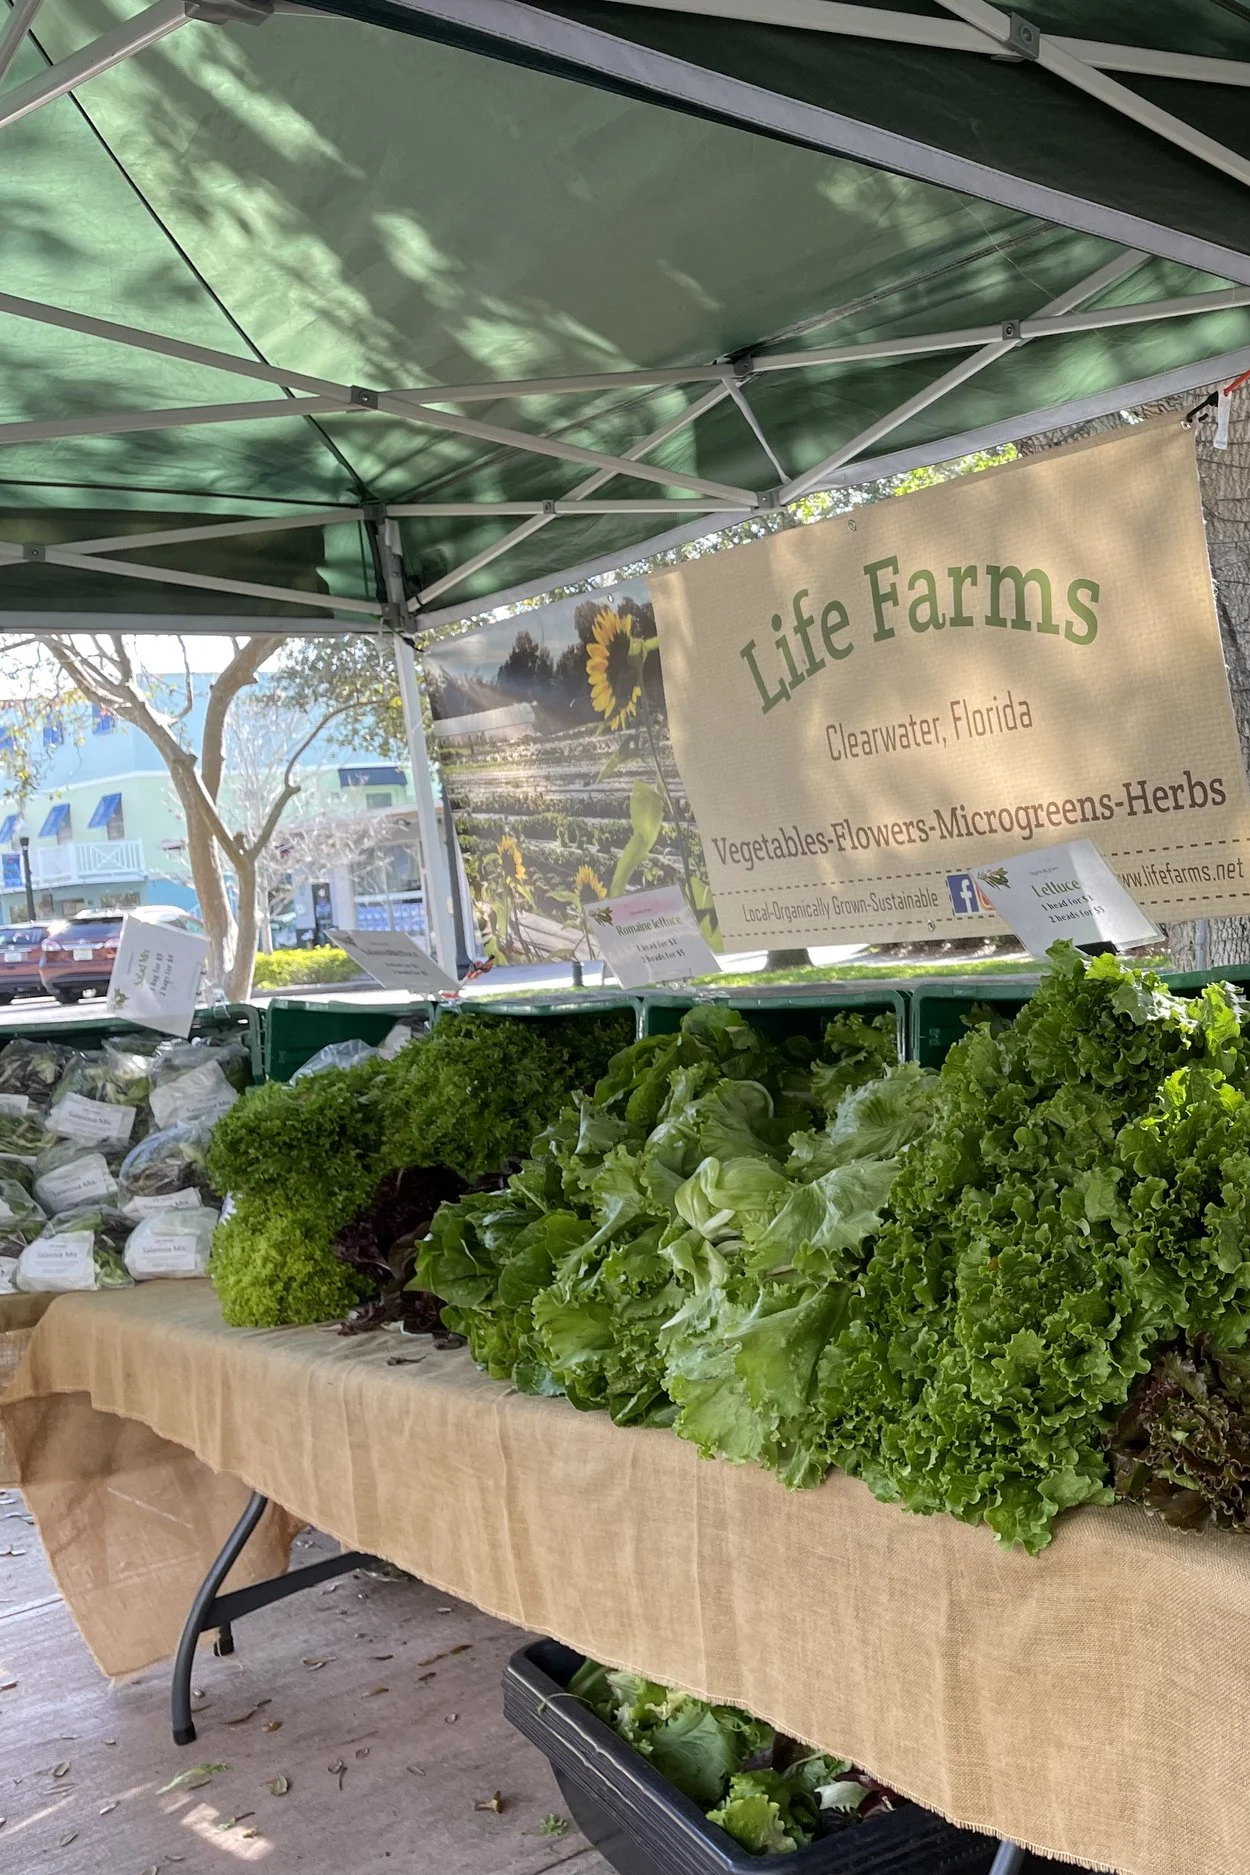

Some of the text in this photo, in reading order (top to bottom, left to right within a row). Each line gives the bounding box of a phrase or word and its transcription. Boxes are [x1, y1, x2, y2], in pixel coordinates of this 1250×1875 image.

[740, 555, 1101, 715] Life Farms
[825, 690, 1033, 762] Clearwater, Florida
[711, 770, 1227, 873] Vegetables-Flowers-Microgreens-Herbs
[1031, 878, 1081, 898] Lettuce
[741, 887, 939, 923] Local-Organically Grown-Sustainable
[1046, 899, 1069, 910] head
[1067, 897, 1082, 906] for
[1048, 915, 1056, 923] 2
[1054, 911, 1080, 922] heads
[1078, 909, 1092, 917] for
[615, 916, 682, 936] Romaine lettuce
